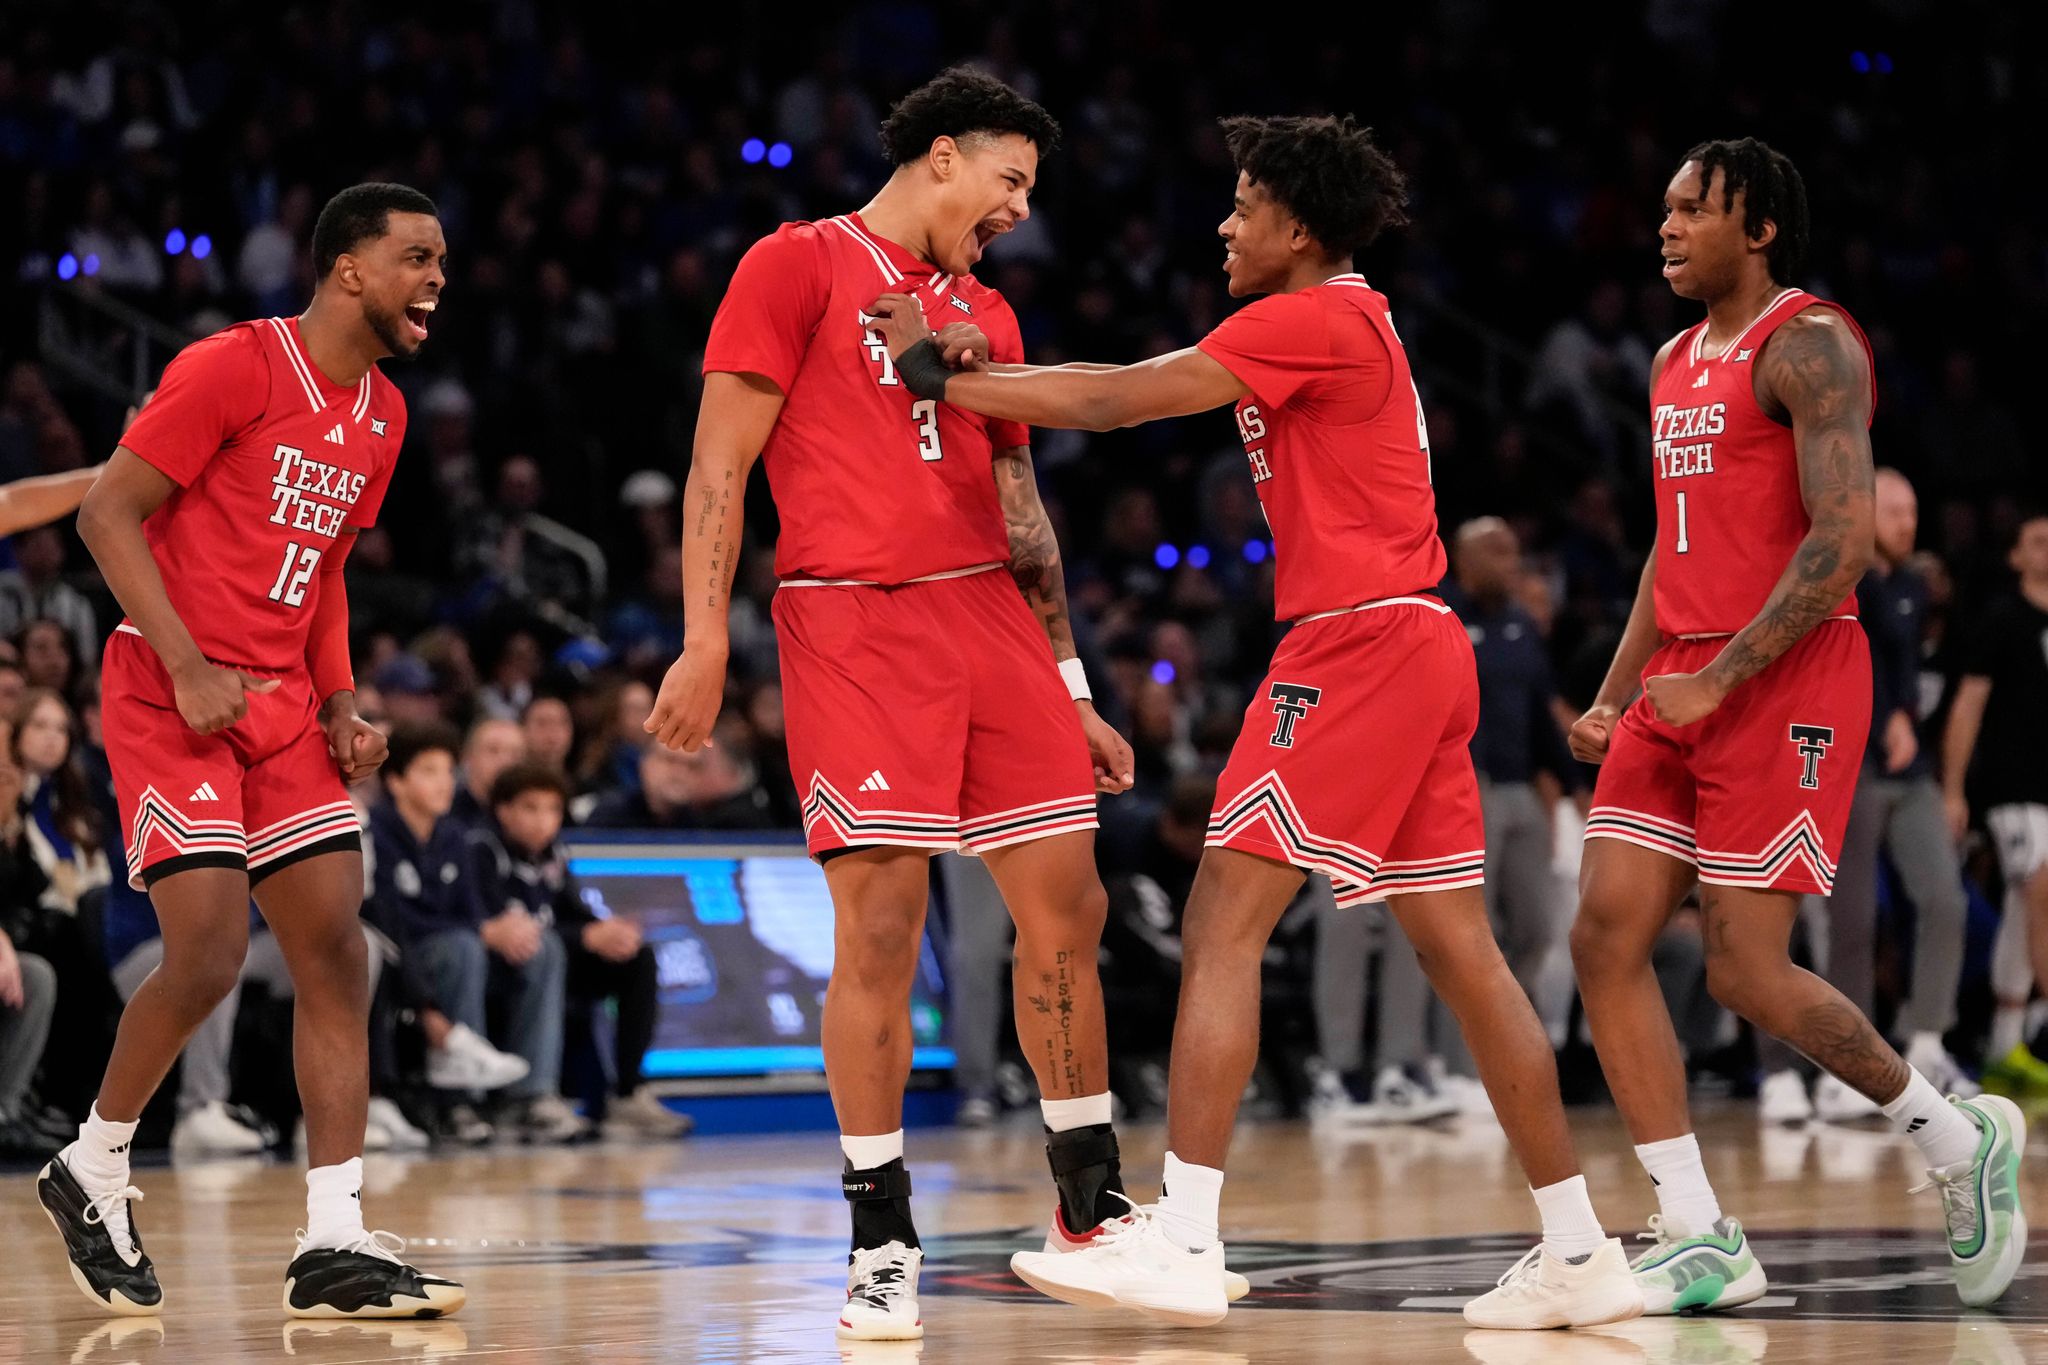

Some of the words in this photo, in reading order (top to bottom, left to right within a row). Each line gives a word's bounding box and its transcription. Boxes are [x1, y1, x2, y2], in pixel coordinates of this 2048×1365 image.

[912, 399, 944, 462] 3
[1653, 402, 1727, 443] TEXAS
[271, 442, 367, 506] TEXAS
[1655, 439, 1715, 481] TECH
[268, 483, 348, 539] TECH
[707, 469, 733, 608] PATIENCE
[1675, 490, 1690, 554] 1
[267, 541, 323, 609] 12
